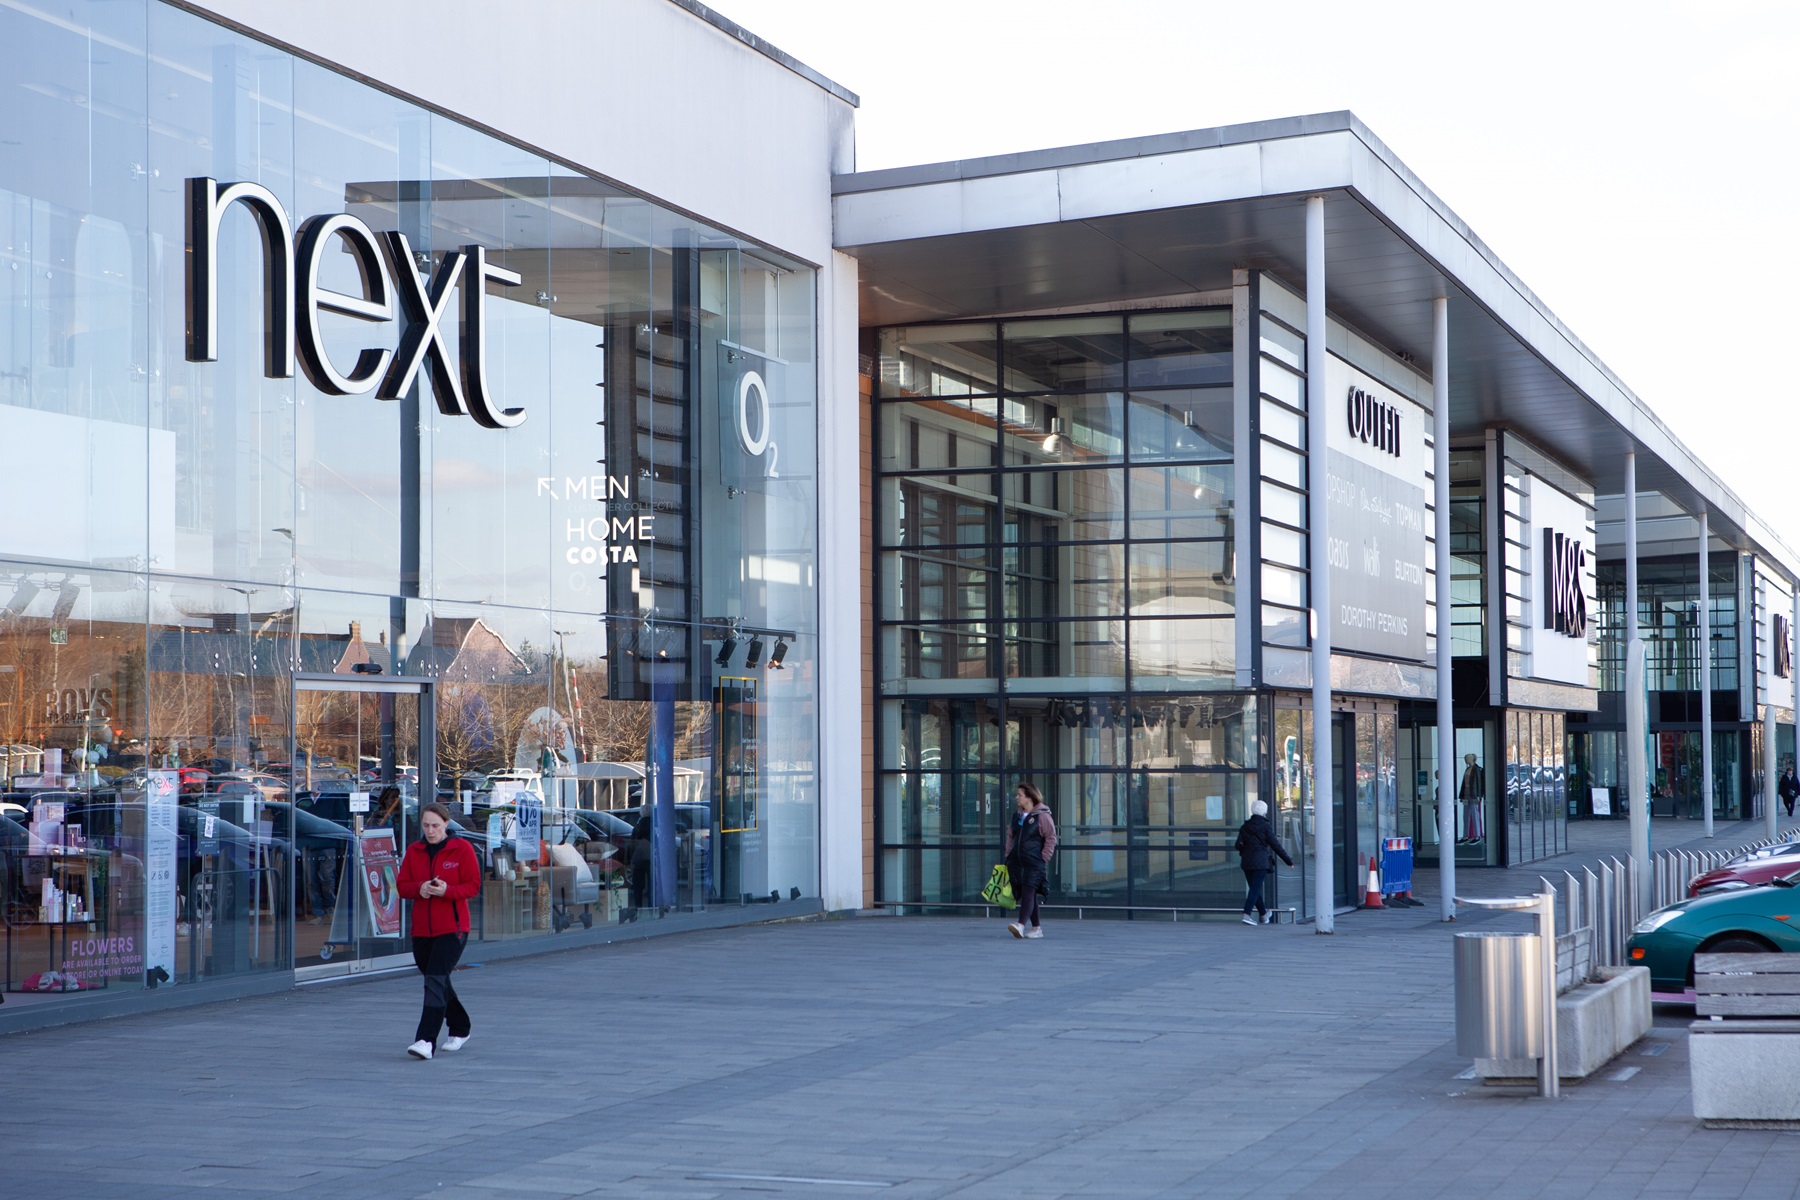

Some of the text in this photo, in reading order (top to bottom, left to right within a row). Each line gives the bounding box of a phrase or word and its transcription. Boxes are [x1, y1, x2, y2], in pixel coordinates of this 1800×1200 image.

[184, 176, 528, 429] next
[1347, 385, 1404, 458] OUTFIT
[565, 475, 629, 500] MEN
[1327, 473, 1356, 508] OPSHOP
[566, 515, 656, 543] HOME
[1395, 502, 1422, 533] TOPMAN
[566, 545, 638, 566] COSTA
[1395, 559, 1423, 586] BURTON
[1543, 527, 1587, 639] M&S
[1341, 604, 1408, 636] DOROTHY PERKINS
[41, 688, 113, 718] BOYS
[71, 936, 134, 957] FLOWERS
[62, 955, 142, 969] ARE AVAILABLE TO ORDER
[89, 970, 97, 978] OR
[100, 968, 121, 977] ONLINE
[123, 965, 144, 975] TODAY
